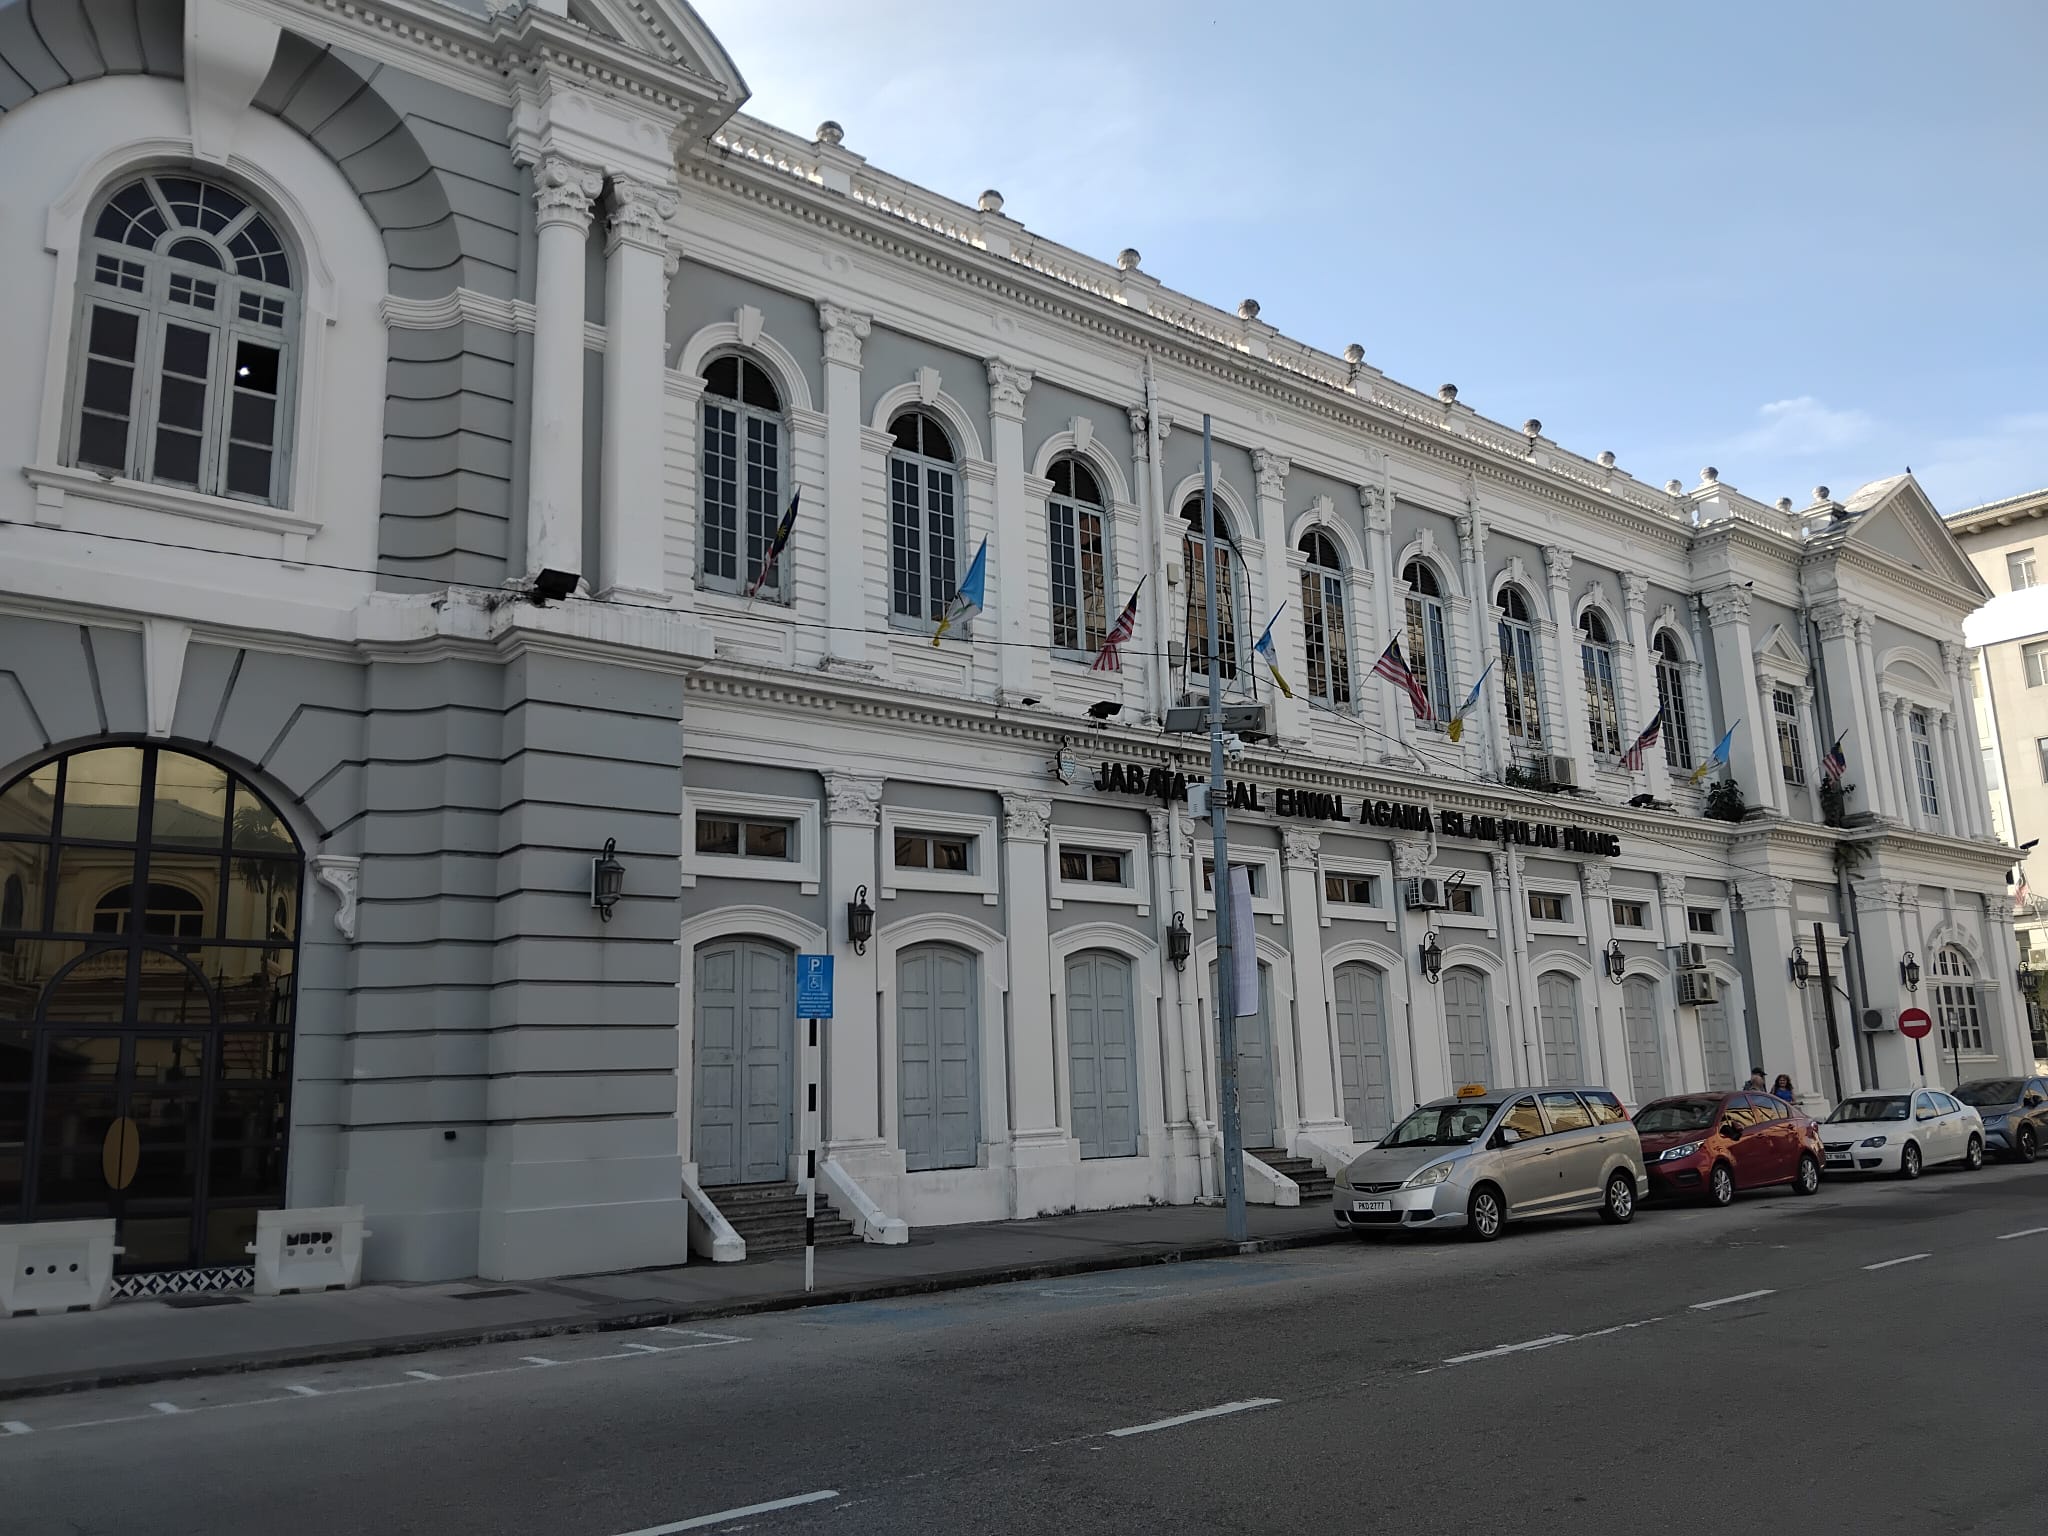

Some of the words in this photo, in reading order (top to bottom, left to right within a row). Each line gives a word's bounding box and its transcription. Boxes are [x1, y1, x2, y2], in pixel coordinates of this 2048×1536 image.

[1094, 762, 1205, 803] JABATA
[1276, 788, 1350, 822] EHWAL
[1360, 799, 1434, 833] AGAMA
[1441, 810, 1497, 841] ISLAM
[1503, 819, 1558, 848] PULAU
[1563, 825, 1621, 857] PINANG
[811, 959, 820, 971] P
[287, 1232, 333, 1246] MBPP
